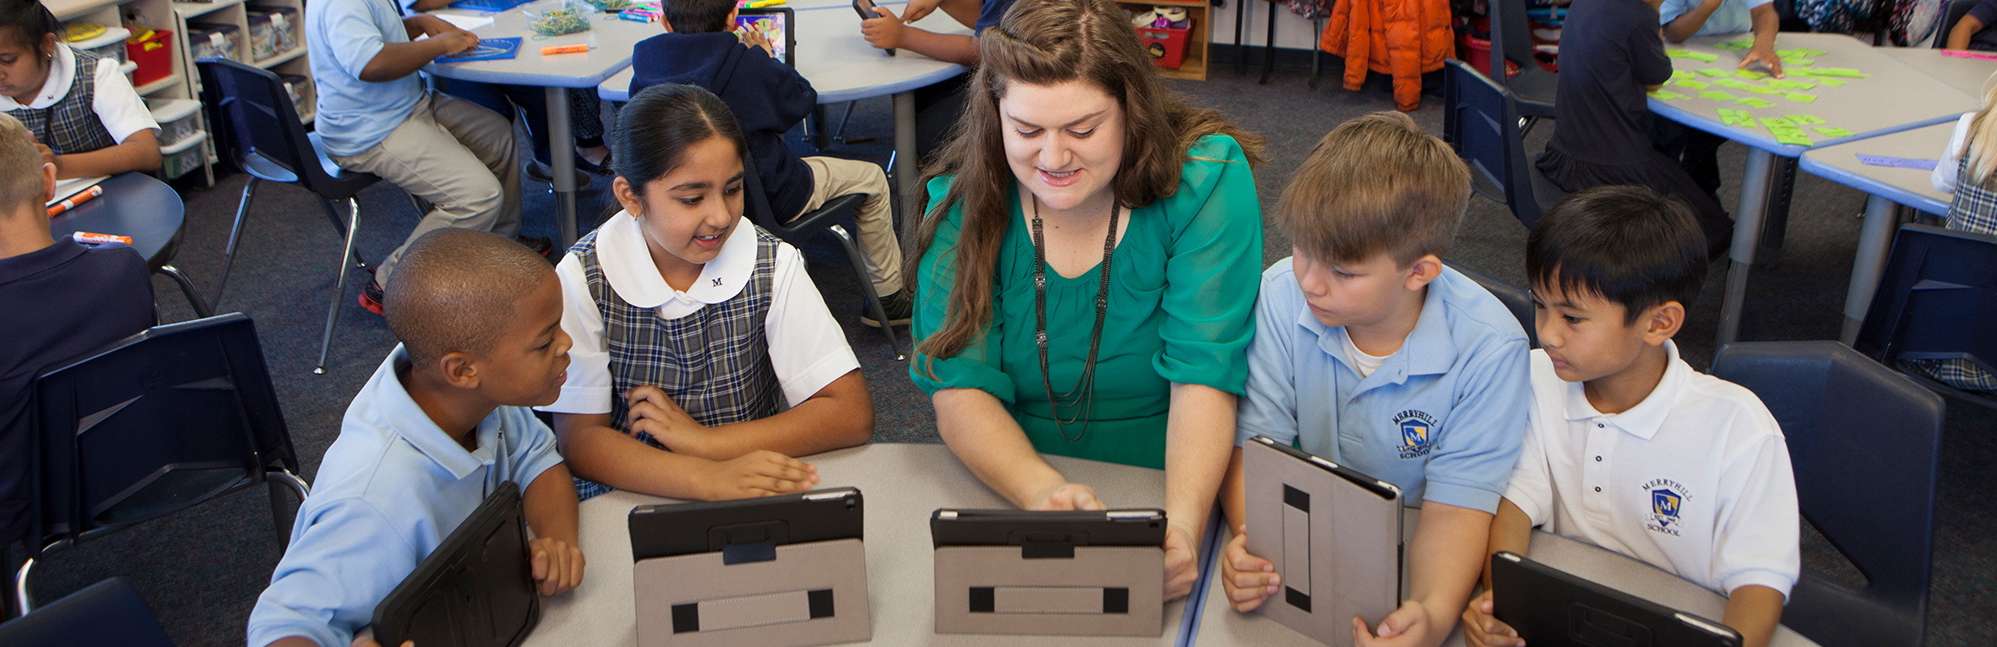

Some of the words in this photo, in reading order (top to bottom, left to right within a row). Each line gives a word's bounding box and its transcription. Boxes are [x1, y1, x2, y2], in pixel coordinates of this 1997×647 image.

[711, 276, 723, 288] M
[1392, 409, 1437, 426] MERRYHILL
[1642, 479, 1692, 501] MERRYHILL
